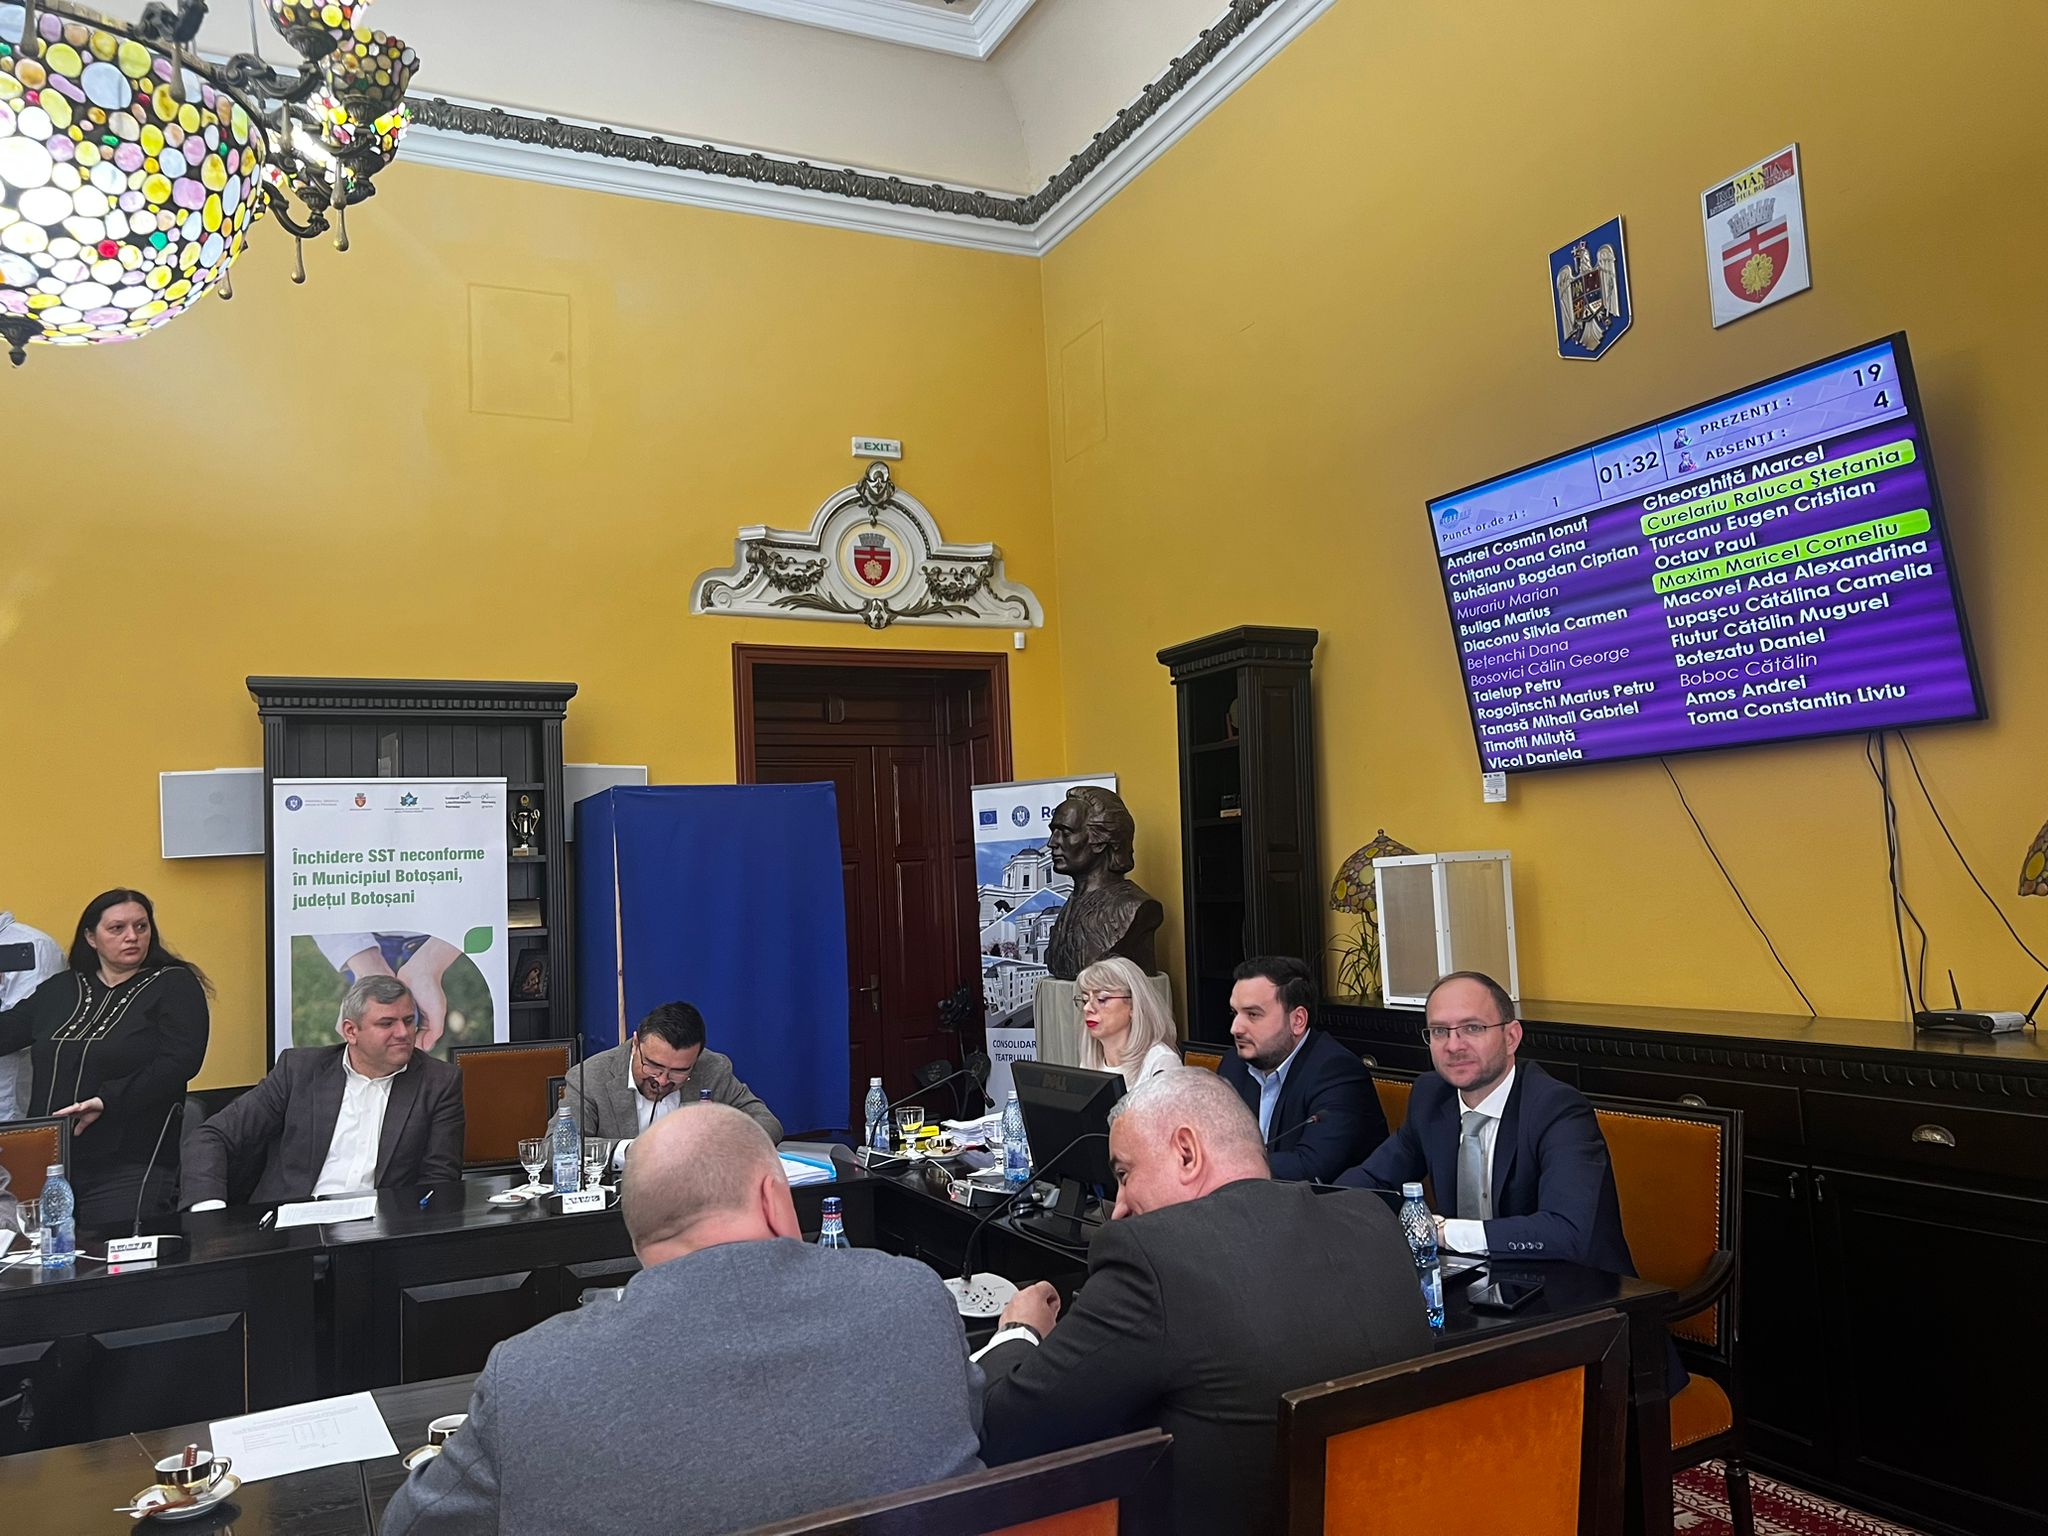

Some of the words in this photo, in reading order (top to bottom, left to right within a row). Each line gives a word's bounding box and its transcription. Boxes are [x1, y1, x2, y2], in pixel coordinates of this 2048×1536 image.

[1853, 363, 1882, 387] 19
[1874, 390, 1889, 409] 4
[864, 442, 891, 451] EXIT
[1752, 445, 1825, 480] Marcel
[1600, 451, 1659, 483] 01:32
[1442, 527, 1472, 542] Punct
[1553, 496, 1559, 508] 1
[1647, 498, 1728, 530] Curelariu
[1734, 478, 1803, 506] Raluca
[1727, 504, 1789, 532] Eugen
[1794, 481, 1876, 512] Cristian
[1447, 547, 1489, 570] Andrei
[1492, 531, 1545, 556] Cosmin
[1504, 553, 1545, 571] Oana
[1549, 538, 1586, 558] Gina
[1519, 560, 1577, 585] Bogdan
[1580, 544, 1639, 570] Ciprian
[1654, 547, 1709, 570] Octav
[1715, 532, 1757, 556] Paul
[1659, 563, 1720, 590] Maxim
[1725, 544, 1800, 575] Maricel
[1806, 522, 1898, 555] Corneliu
[1662, 580, 1742, 610] Macovei
[1747, 571, 1788, 591] Ada
[1793, 540, 1928, 581] Alexandrina
[1745, 583, 1831, 613] Cătălina
[1836, 561, 1933, 593] Camelia
[1457, 600, 1505, 620] Murariu
[1509, 585, 1559, 609] Marian
[1460, 618, 1501, 637] Buliga
[1504, 606, 1551, 626] Marius
[1463, 633, 1520, 653] Diaconu
[1522, 622, 1560, 640] Silvia
[1564, 608, 1628, 631] Carmen
[1671, 629, 1719, 648] Flutur
[1723, 612, 1794, 638] Cătălin
[1799, 593, 1890, 620] Mugurel
[1529, 639, 1569, 658] Dana
[1675, 642, 1755, 668] Botezatu
[1760, 627, 1826, 653] Daniel
[1470, 666, 1525, 687] Bosovici
[1527, 658, 1566, 677] Călin
[1569, 646, 1630, 668] George
[1680, 667, 1740, 688] Boboc
[1744, 653, 1818, 677] Cătălin
[1477, 696, 1557, 720] Rogojinschi
[1560, 686, 1610, 706] Marius
[1613, 680, 1655, 698] Petru
[1525, 678, 1562, 694] Petru
[1685, 687, 1737, 707] Amos
[1742, 675, 1807, 698] Andrei
[1480, 718, 1529, 736] Tanasă
[1532, 711, 1576, 729] Mihail
[1580, 701, 1639, 722] Gabriel
[1687, 708, 1739, 726] Toma
[1743, 691, 1852, 718] Constantin
[1857, 683, 1906, 704] Liviu
[1484, 735, 1528, 753] Timofti
[1488, 754, 1523, 769] Vicol
[1526, 747, 1583, 765] Daniela
[292, 847, 364, 865] Închidere
[368, 849, 395, 863] SST
[400, 847, 485, 862] neconforme
[292, 872, 307, 886] în
[312, 869, 390, 886] Municipiul
[992, 1039, 1037, 1049] CONSOLIDAR
